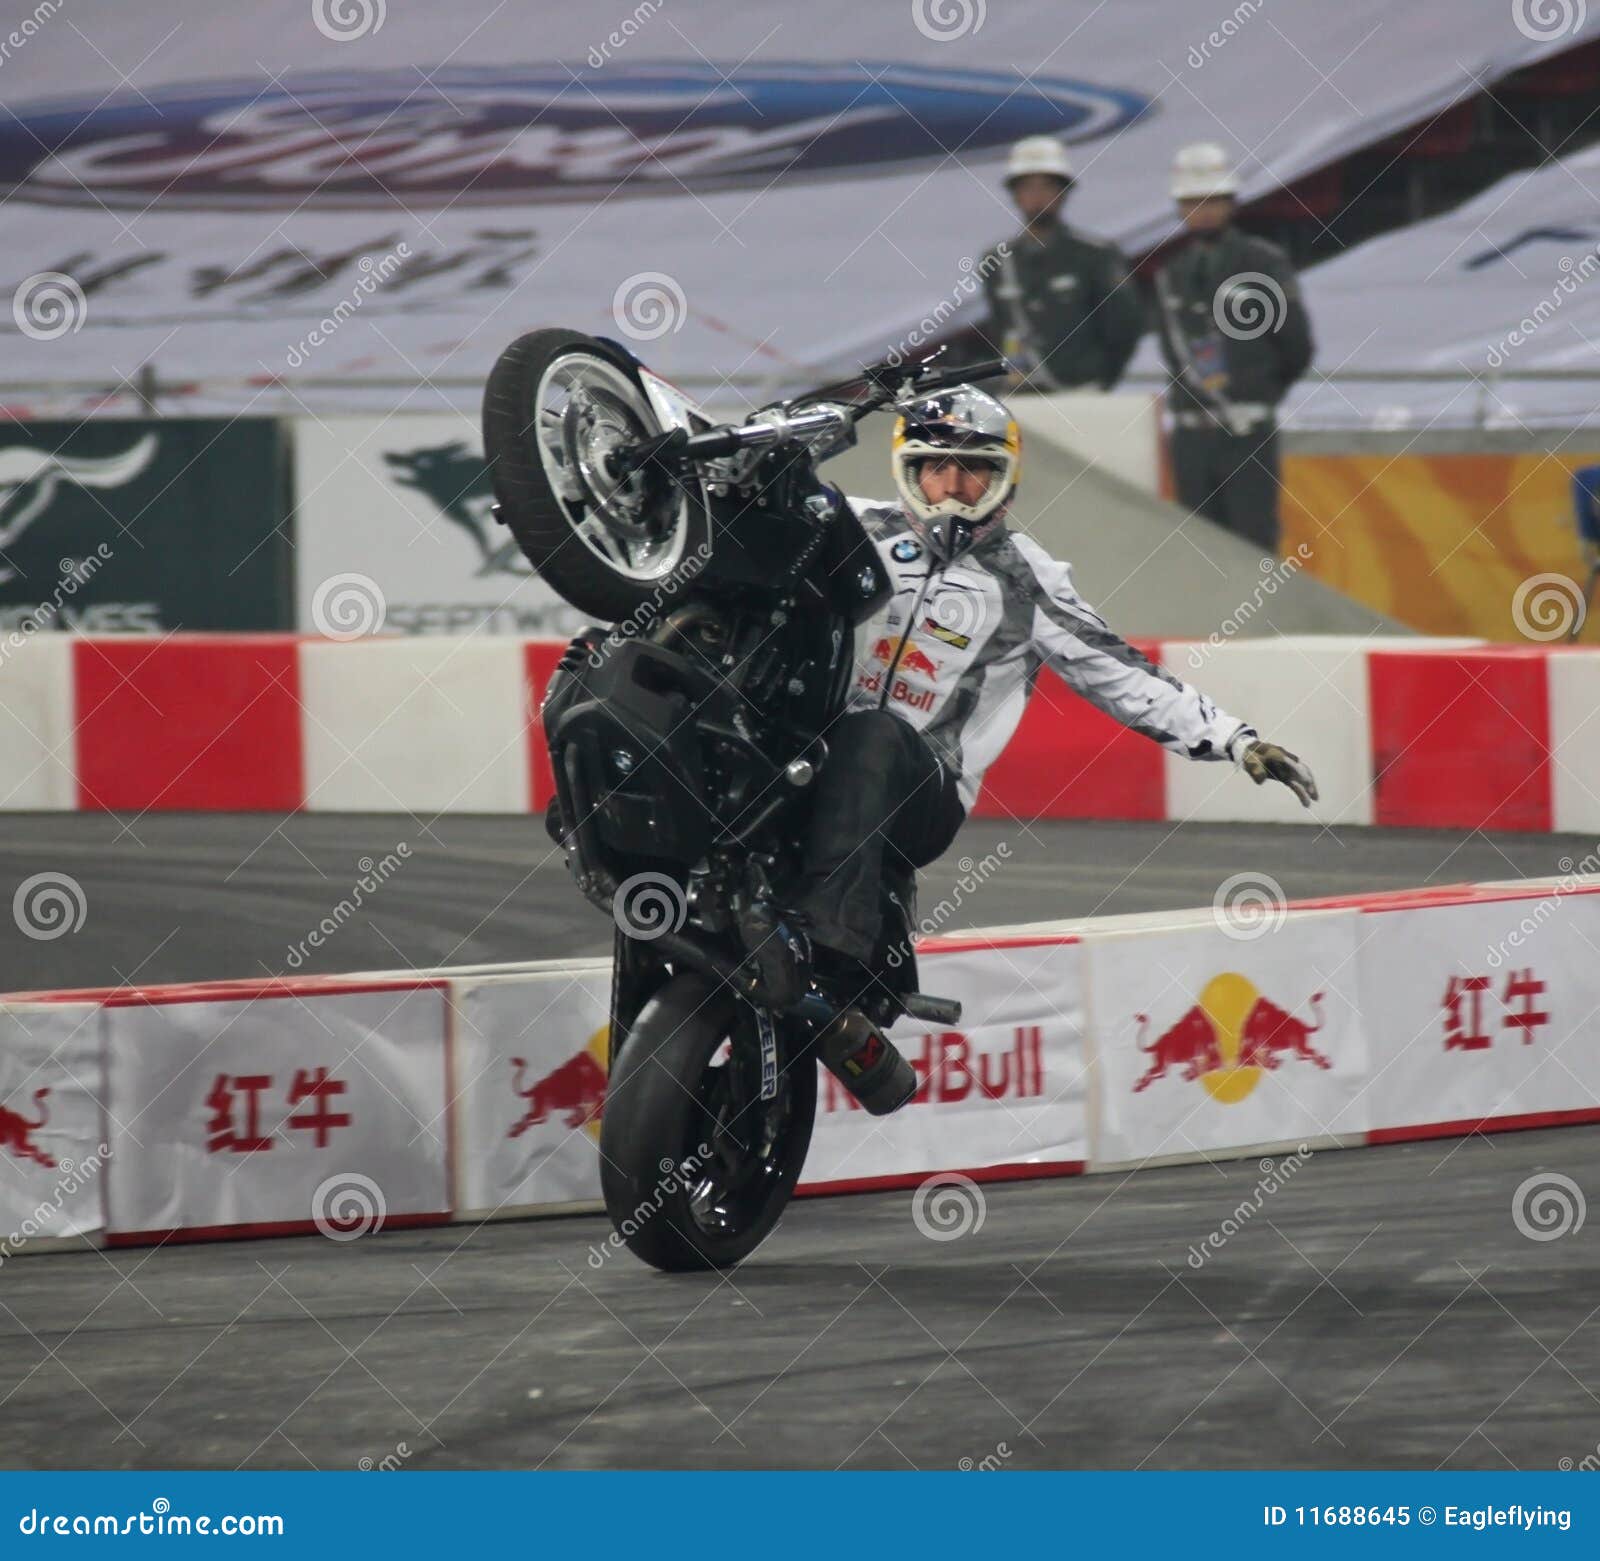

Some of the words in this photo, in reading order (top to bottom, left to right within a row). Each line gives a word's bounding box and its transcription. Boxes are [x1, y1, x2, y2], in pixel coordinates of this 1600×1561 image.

[891, 680, 936, 712] Bull
[1443, 967, 1550, 1052] 红牛
[205, 1066, 352, 1153] 红牛
[825, 1026, 1044, 1113] dBull
